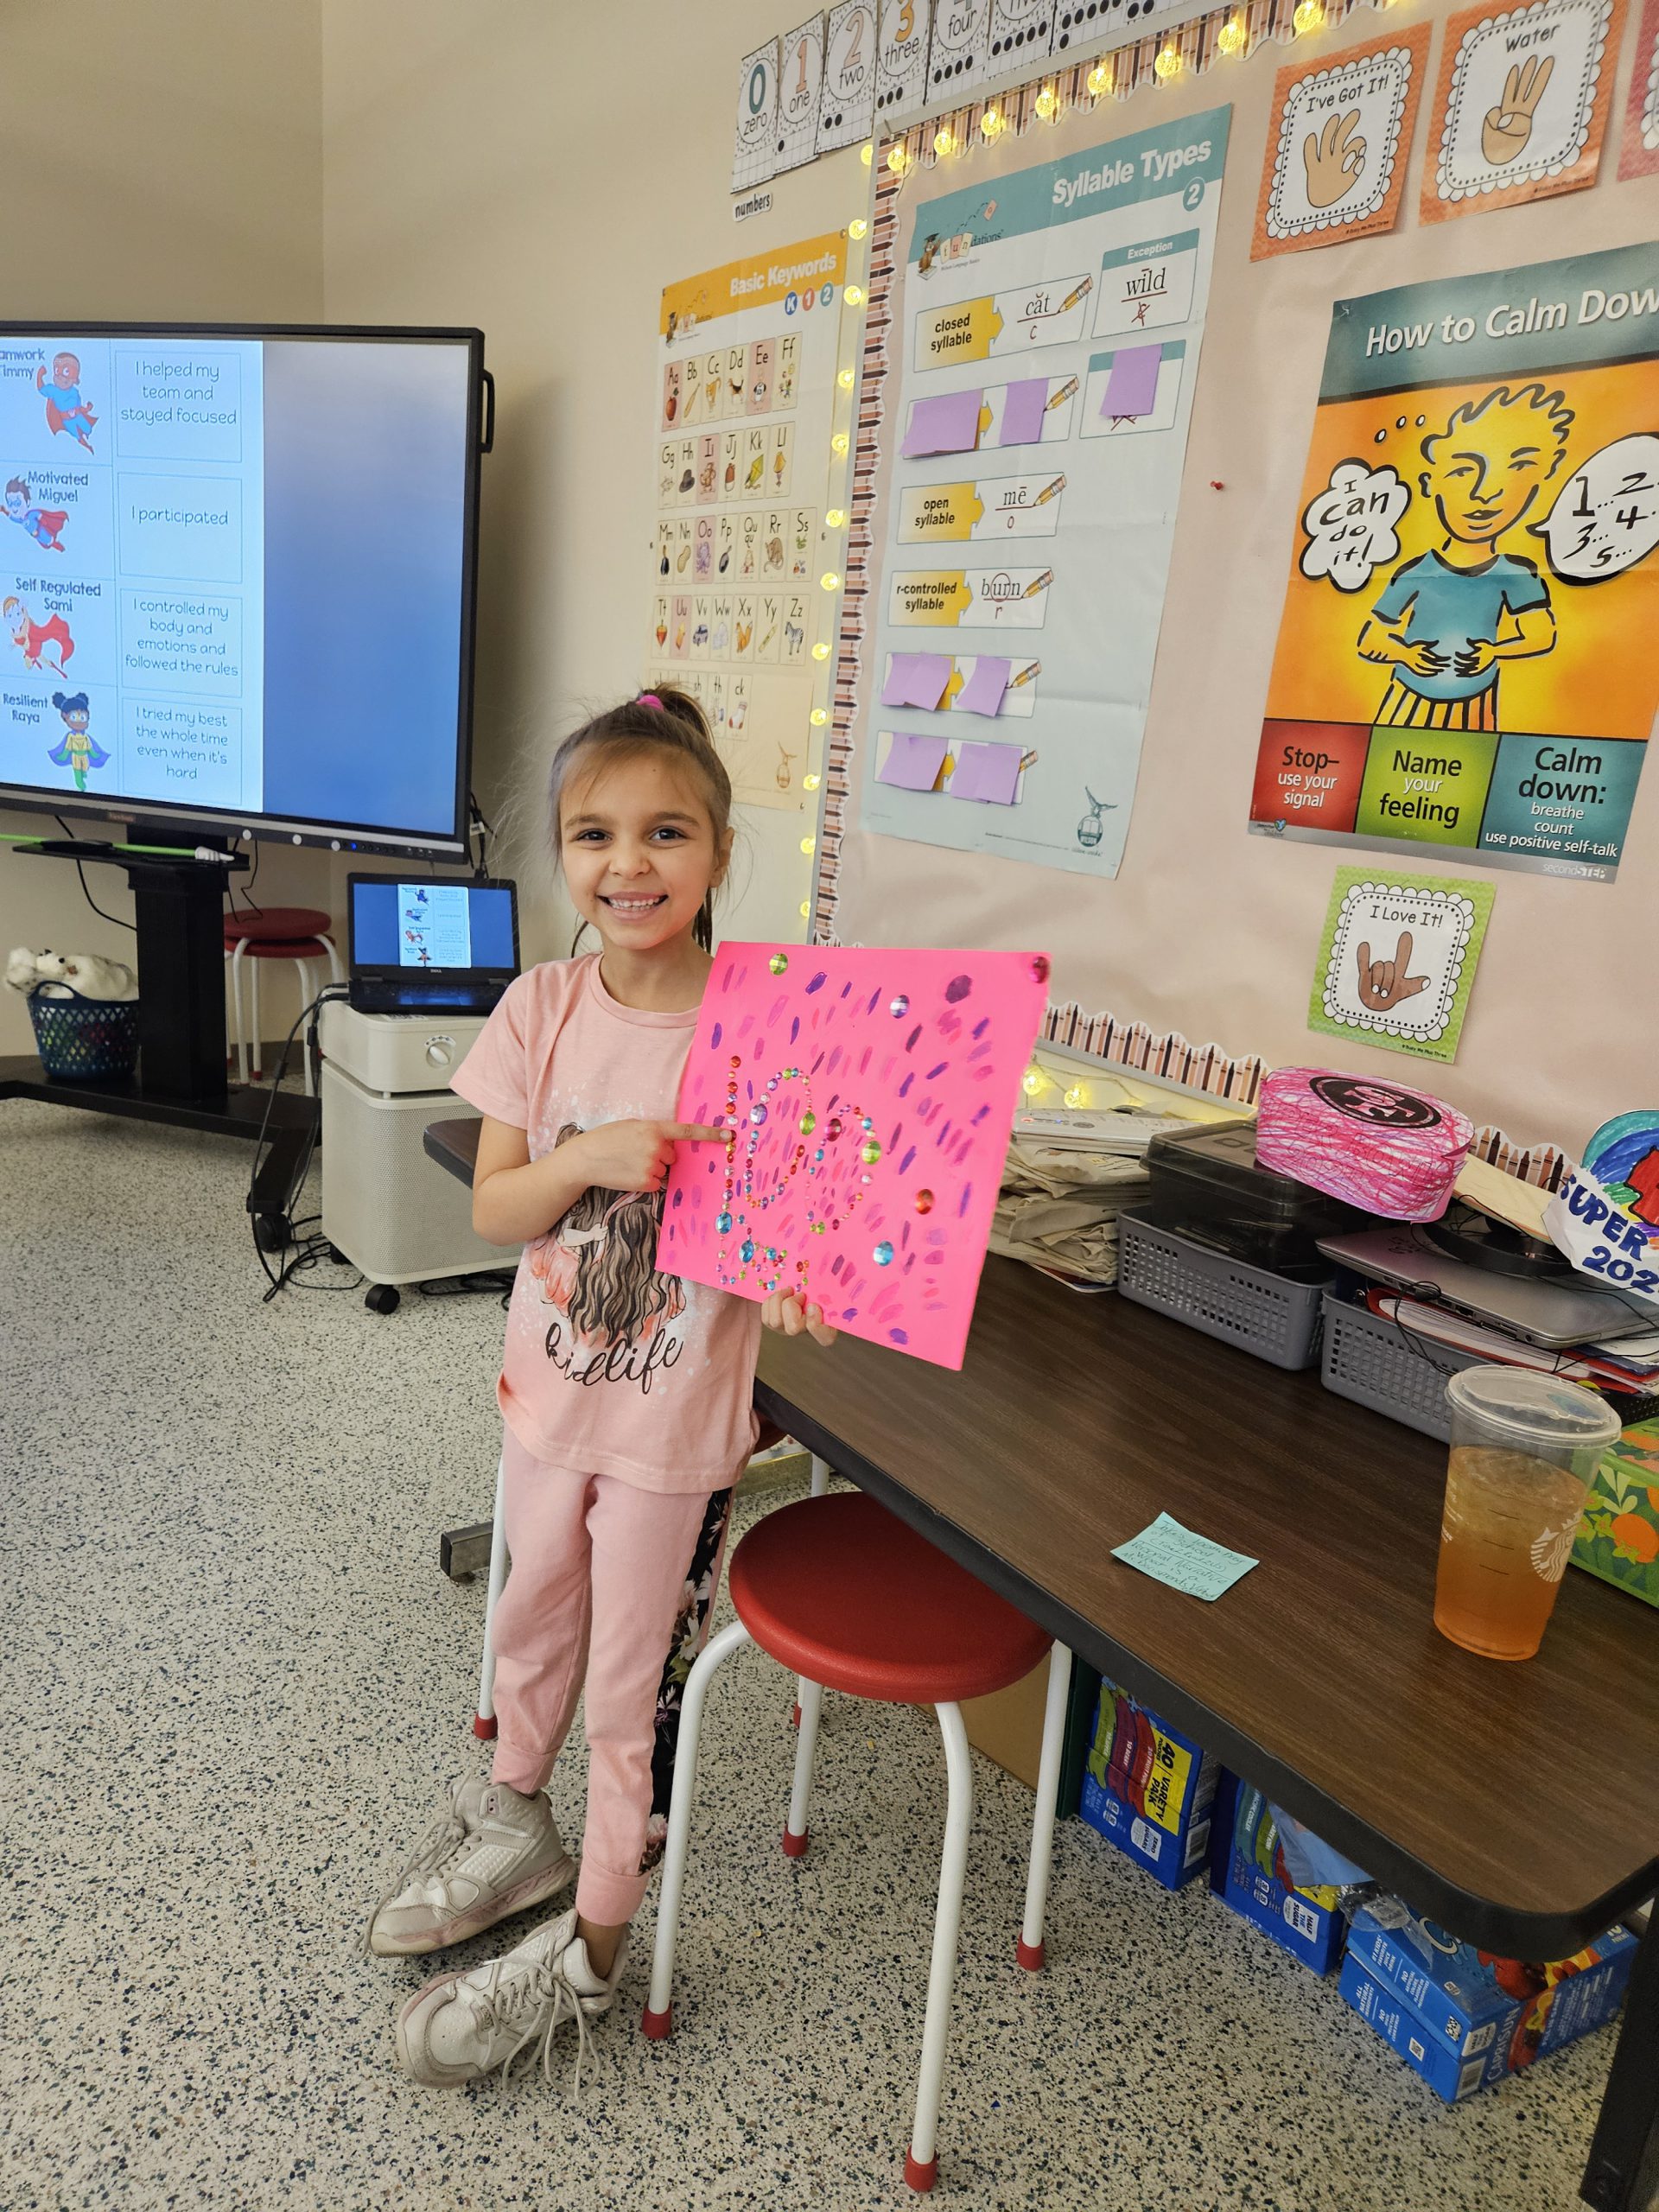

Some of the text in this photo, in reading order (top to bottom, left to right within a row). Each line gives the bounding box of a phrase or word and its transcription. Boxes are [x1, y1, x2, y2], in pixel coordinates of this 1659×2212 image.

[948, 9, 977, 39] four
[843, 10, 865, 71] 2
[1506, 24, 1560, 53] Water
[884, 37, 920, 67] three
[796, 39, 808, 93] 1
[838, 65, 865, 90] two
[749, 64, 766, 114] 0
[1306, 74, 1389, 113] I've Got It!
[789, 91, 810, 113] one
[743, 111, 767, 137] zero
[1052, 140, 1212, 208] Syllable Types
[1186, 183, 1200, 206] 2
[734, 192, 771, 219] numbers
[1127, 240, 1173, 259] Exception
[730, 251, 837, 297] Basic Keywords
[786, 296, 796, 313] K
[822, 287, 832, 302] 2
[935, 313, 970, 334] closed
[1365, 320, 1433, 358] How
[1440, 315, 1476, 344] to
[1484, 297, 1567, 339] Calm
[931, 331, 973, 352] syllable
[729, 349, 744, 371] Dd
[755, 344, 769, 365] Ee
[143, 361, 192, 379] helped
[196, 366, 219, 382] my
[143, 386, 213, 401] team and
[121, 408, 237, 426] stayed focused
[28, 471, 88, 486] Motivated
[1343, 480, 1357, 494] I
[39, 488, 78, 503] Miguel
[924, 498, 949, 513] open
[138, 507, 228, 526] participated
[1319, 491, 1389, 525] can
[697, 520, 712, 538] Oo
[770, 514, 782, 534] Rr
[797, 512, 810, 532] Ss
[915, 512, 955, 528] syllable
[721, 518, 733, 543] Pp
[1329, 524, 1367, 542] do
[1333, 535, 1374, 568] it!
[16, 577, 101, 596] Self Regulated
[896, 582, 957, 597] r-controlled
[44, 597, 73, 612] Sami
[140, 599, 205, 615] controlled
[208, 607, 229, 621] my
[738, 597, 752, 617] Xx
[764, 598, 777, 623] Yy
[790, 598, 803, 618] Zz
[905, 598, 944, 613] syllable
[150, 619, 213, 637] body and
[137, 639, 226, 655] emotions and
[125, 655, 238, 677] followed the rules
[734, 677, 745, 696] ck
[3, 694, 48, 709] Resilient
[12, 709, 41, 724] Raya
[143, 708, 172, 721] tried
[175, 713, 195, 728] my
[198, 712, 227, 728] best
[136, 726, 228, 747] the whole time
[137, 746, 227, 764] even when it's
[1393, 750, 1462, 776] Name
[1535, 747, 1603, 774] Calm
[166, 766, 198, 779] hard
[1277, 772, 1338, 791] use your
[1403, 776, 1443, 794] your
[1517, 773, 1607, 804] down:
[1283, 790, 1325, 809] signal
[1378, 793, 1460, 830] feeling
[1530, 802, 1584, 821] breathe
[1534, 820, 1575, 836] count
[1484, 832, 1618, 858] use positive self-talk
[1370, 905, 1443, 929] I Love It!
[1161, 1742, 1175, 1770] 40
[1159, 1776, 1171, 1821] VARETY
[1401, 1971, 1408, 1983] NO
[1359, 1982, 1370, 2013] NATURAL
[1378, 2009, 1386, 2022] NO
